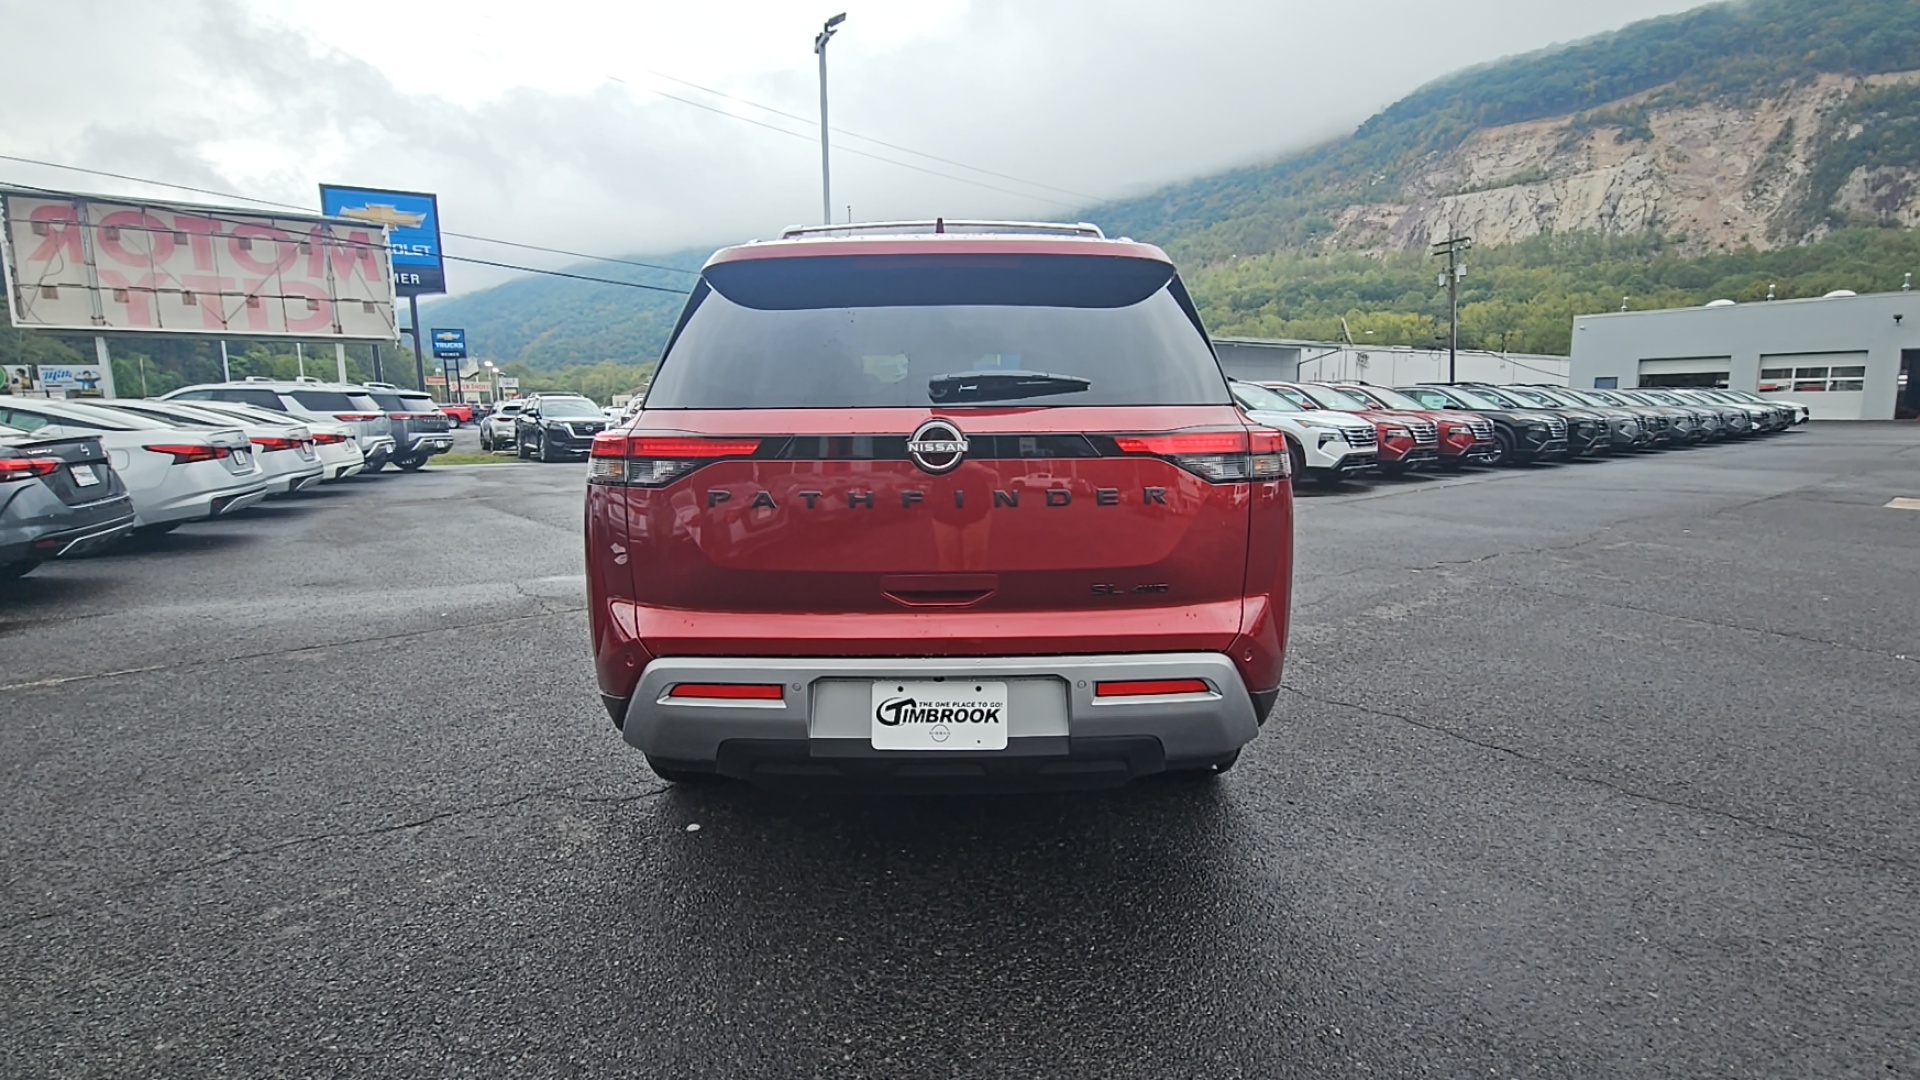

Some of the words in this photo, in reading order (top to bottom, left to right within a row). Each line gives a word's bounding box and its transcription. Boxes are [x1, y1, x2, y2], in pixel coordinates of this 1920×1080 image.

[390, 243, 432, 256] OLET
[434, 341, 464, 349] TRUCKS
[907, 441, 968, 453] NISSAN
[706, 485, 1168, 510] PATHFINDER
[1090, 583, 1124, 596] SL
[877, 697, 1001, 726] TIMBROOK
